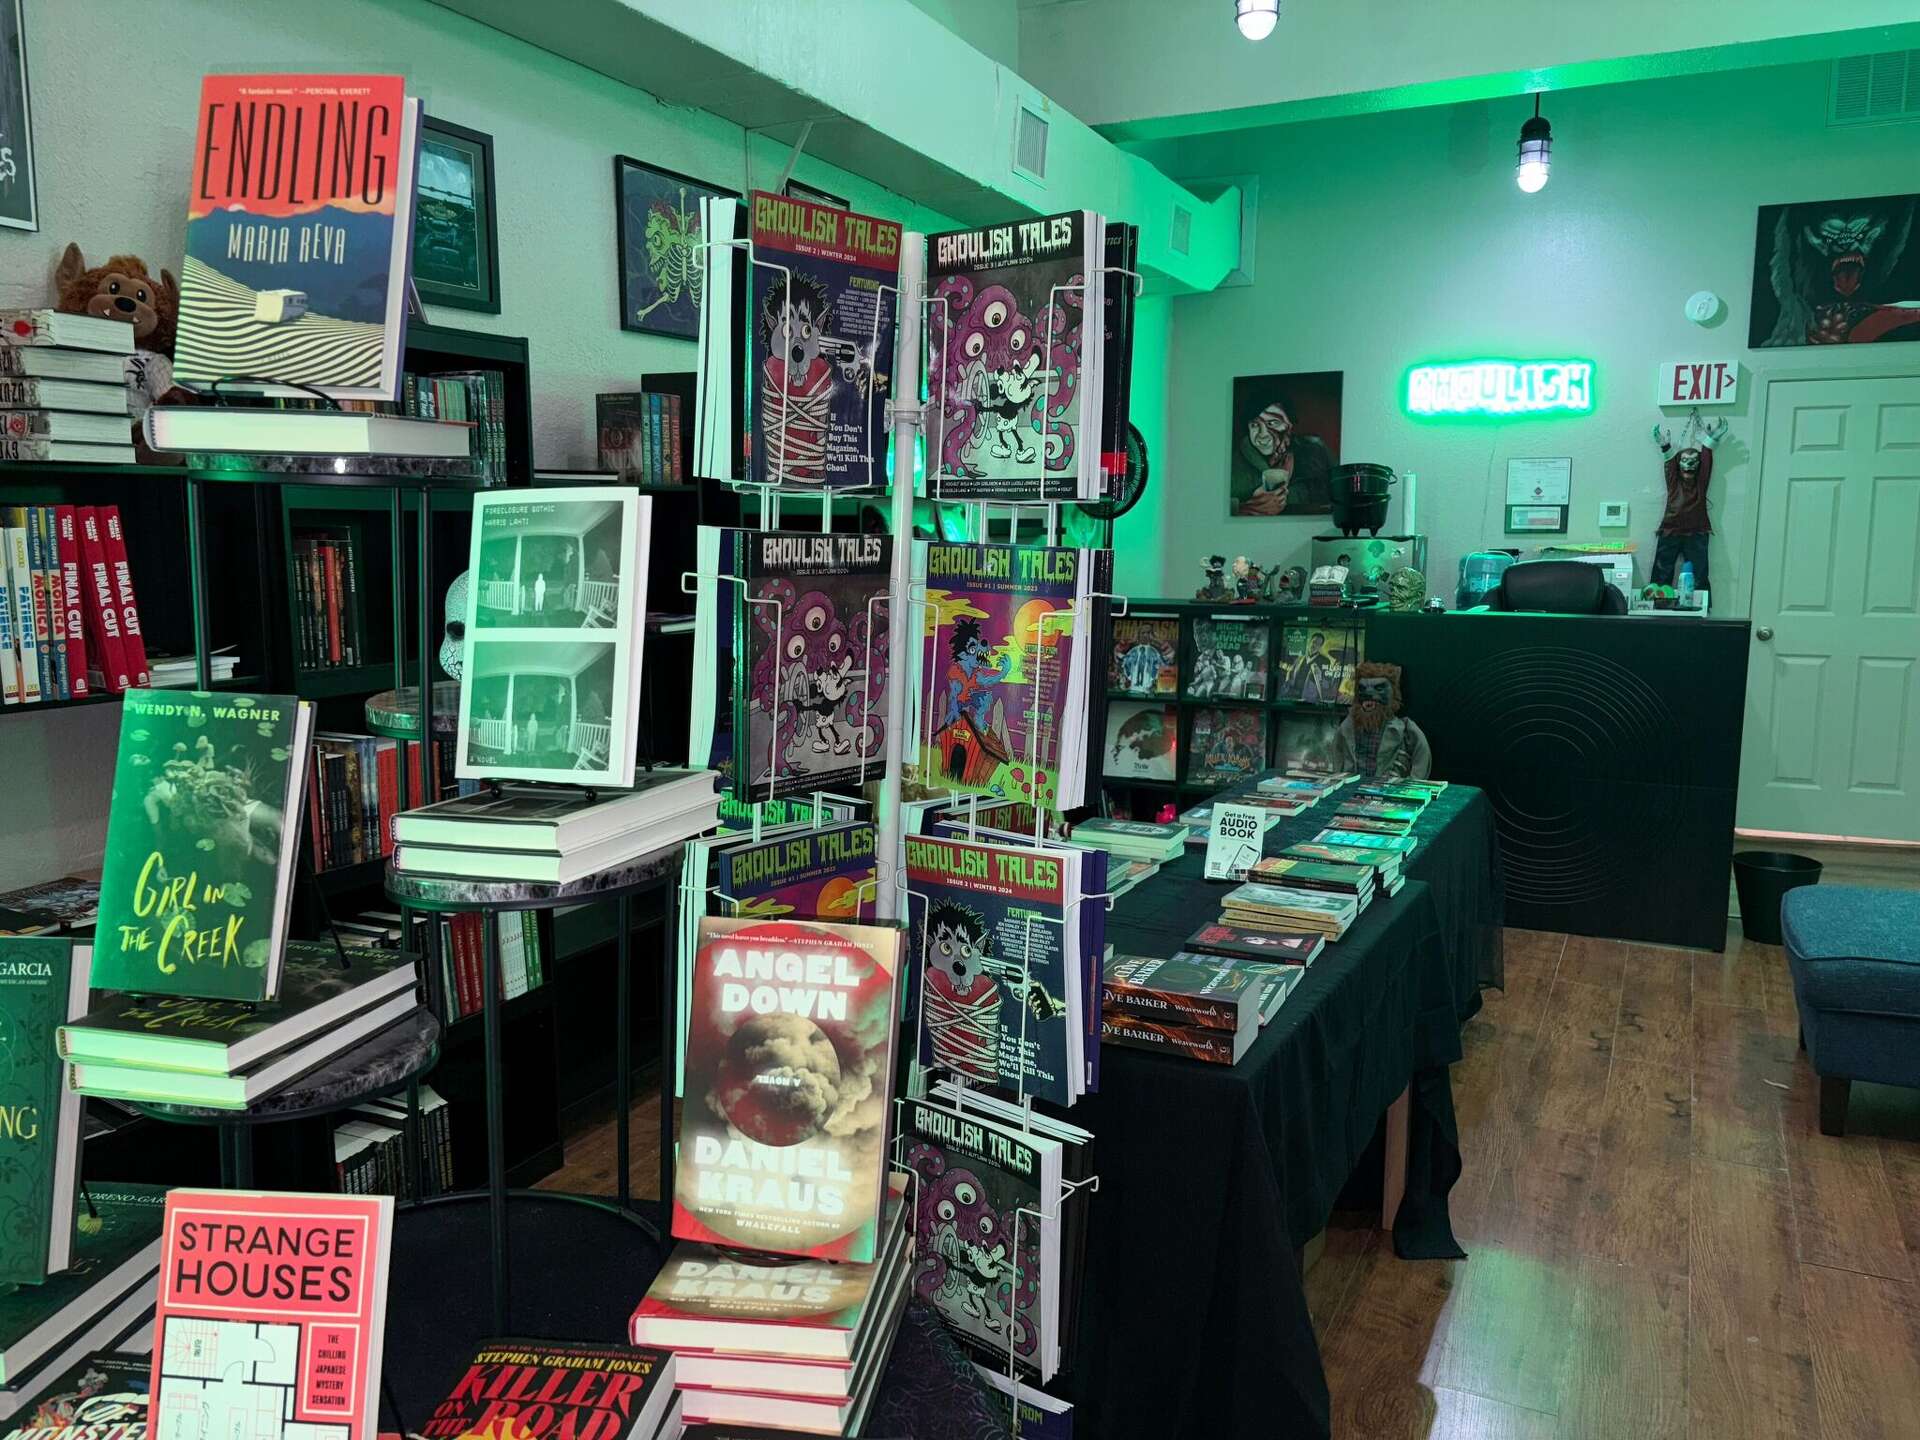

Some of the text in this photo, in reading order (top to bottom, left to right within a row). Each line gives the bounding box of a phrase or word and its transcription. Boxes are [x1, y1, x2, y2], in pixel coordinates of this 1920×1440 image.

[200, 101, 390, 205] ENDLING
[755, 196, 898, 258] GHOULISH TALES
[228, 224, 346, 265] MARIA REVA
[795, 244, 812, 253] ISSUE
[821, 249, 843, 260] WINTER
[937, 217, 1073, 270] GHOULISH TALES
[1407, 362, 1592, 414] GHOULISH
[1672, 363, 1729, 401] EXIT
[828, 434, 858, 443] Buy This
[830, 424, 863, 433] You Don't
[826, 443, 860, 454] Magazine,
[826, 454, 843, 462] We'll
[844, 455, 858, 463] Kill
[826, 464, 848, 472] Ghoul
[484, 506, 528, 514] FORECLOSURE
[763, 537, 882, 569] GHOULISH TALES
[929, 546, 1075, 584] GHOULISH TALES
[966, 581, 983, 589] ISSUE
[997, 583, 1021, 591] SUMMER
[34, 575, 48, 635] MONICA
[51, 575, 64, 635] MONICA
[64, 562, 83, 640] FINAL CUT
[92, 562, 119, 638] FINAL CUT
[114, 561, 141, 636] FINAL CUT
[19, 586, 35, 649] PATIENCE
[134, 704, 280, 721] WENDY N. WAGNER
[1220, 818, 1258, 830] AUDIO
[1220, 827, 1255, 840] BOOK
[732, 827, 874, 887] GHOULISH TALES
[907, 841, 988, 880] GHOULISH
[995, 854, 1058, 891] TALES
[134, 851, 225, 917] GIRL IN
[947, 878, 963, 886] ISSUE
[973, 883, 997, 892] WINTER
[998, 886, 1013, 894] 2024
[118, 914, 245, 974] THE CREEK
[0, 962, 52, 977] GARCIA
[714, 949, 861, 987] ANGEL
[1128, 959, 1168, 985] BARKER
[721, 984, 848, 1021] DOWN
[1127, 996, 1168, 1010] BARKER
[1001, 1025, 1008, 1033] If
[1001, 1034, 1017, 1044] You
[1123, 1028, 1165, 1043] BARKER
[1000, 1043, 1015, 1054] Buy
[756, 1075, 791, 1086] NOVEL
[999, 1060, 1055, 1082] We'll Kill This
[915, 1105, 1033, 1175] GHOULISH TALES
[694, 1136, 853, 1182] DANIEL
[697, 1171, 845, 1216] KRAUS
[736, 1219, 801, 1234] WHALEFALL
[179, 1222, 355, 1258] STRANGE
[176, 1259, 353, 1302] HOUSES
[676, 1261, 842, 1286] DANIEL
[671, 1279, 832, 1303] KRAUS
[327, 1334, 339, 1344] THE
[317, 1349, 347, 1360] CHILLING
[473, 1352, 540, 1365] STEPHEN
[543, 1355, 604, 1370] GRAHAM
[605, 1359, 653, 1375] JONES
[315, 1364, 346, 1375] JAPANESE
[315, 1380, 344, 1391] MYSTERY
[448, 1363, 644, 1419] KILLER
[312, 1394, 346, 1406] SENSATION
[434, 1400, 470, 1418] ON
[421, 1417, 472, 1436] THE
[470, 1400, 621, 1440] ROAD
